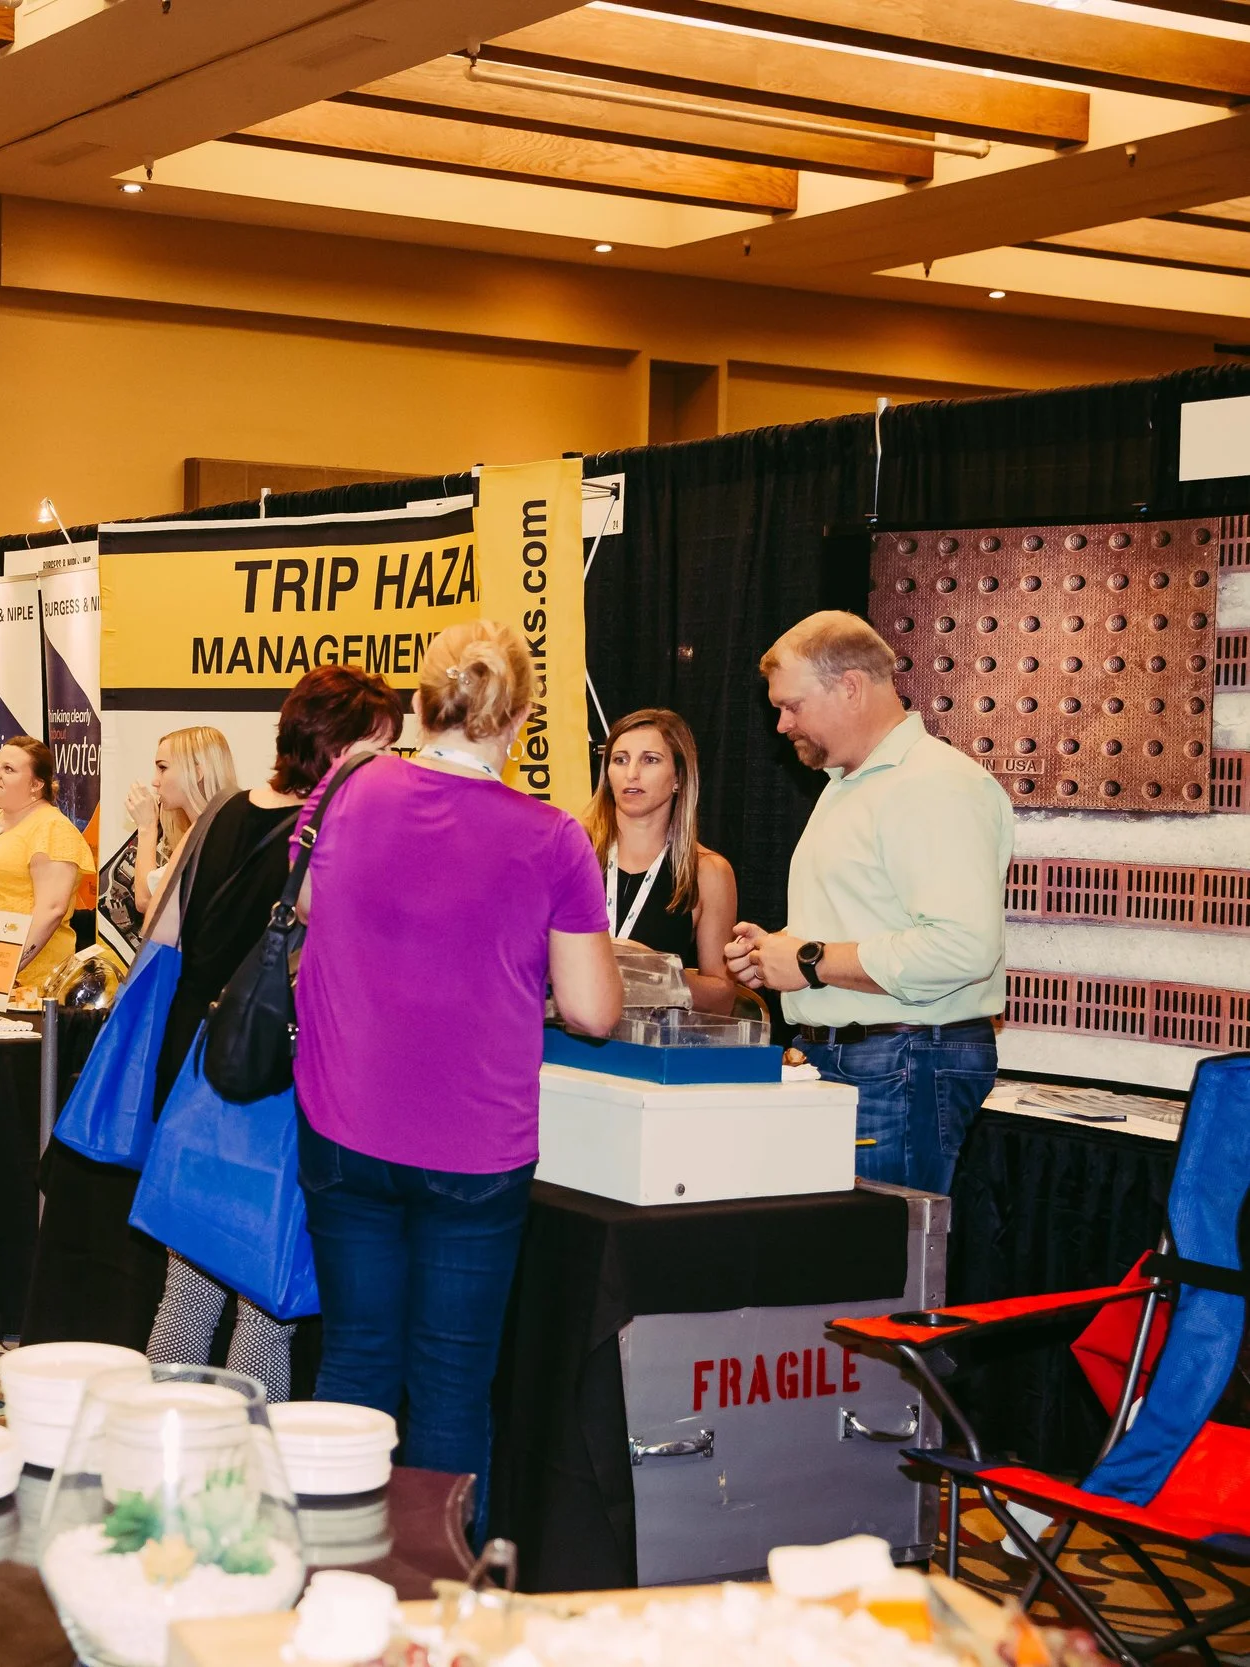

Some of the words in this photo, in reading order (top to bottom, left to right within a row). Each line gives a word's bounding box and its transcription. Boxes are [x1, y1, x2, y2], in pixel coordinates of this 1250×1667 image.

[612, 519, 619, 530] 24
[234, 556, 359, 613] TRIP
[373, 544, 480, 610] HAZA
[7, 605, 34, 621] NIPLE
[45, 598, 80, 617] BURGESS
[83, 597, 89, 613] &
[191, 631, 441, 674] MANAGEMEN
[70, 708, 92, 727] clearly
[1005, 759, 1037, 772] USA
[693, 1344, 861, 1412] FRAGILE
